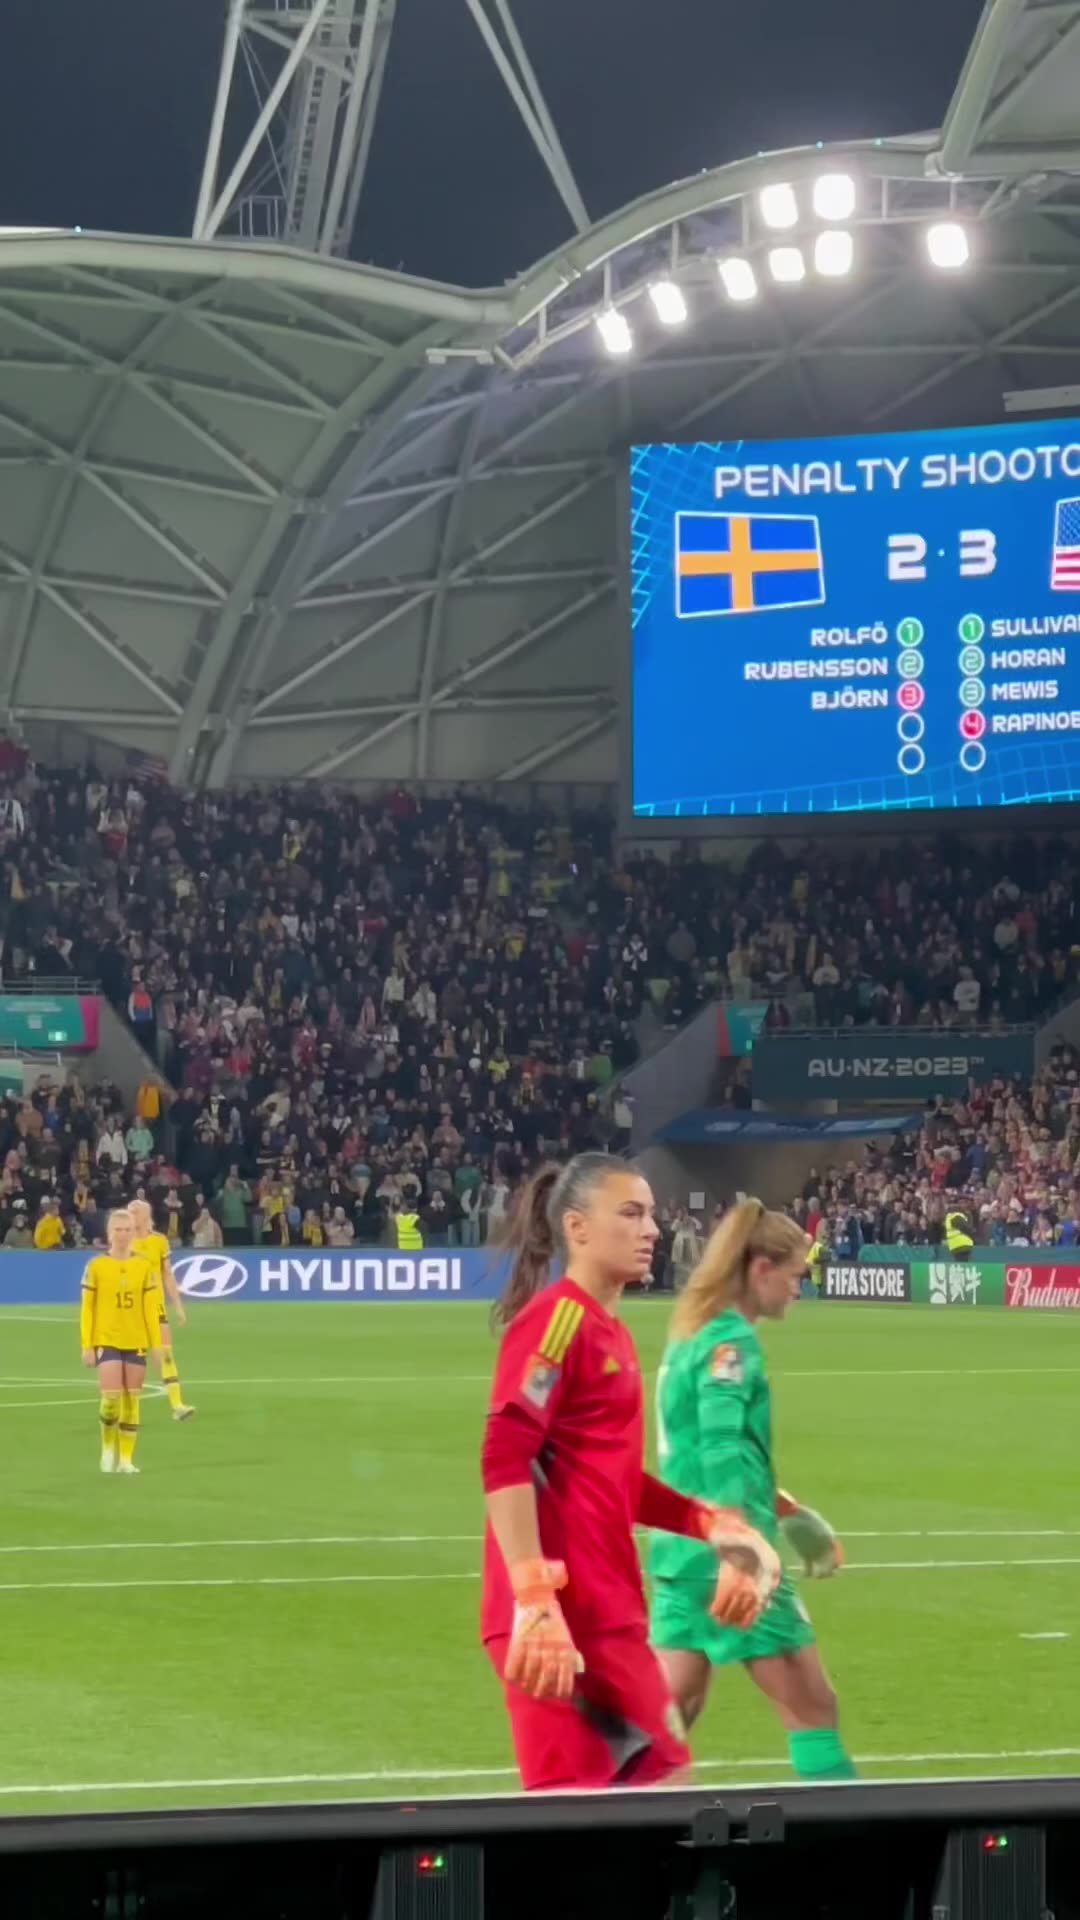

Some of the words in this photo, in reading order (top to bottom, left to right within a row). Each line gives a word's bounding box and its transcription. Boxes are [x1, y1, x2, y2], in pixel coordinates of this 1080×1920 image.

[714, 456, 909, 499] PENALTY
[888, 533, 927, 581] 2
[959, 528, 997, 577] 3
[810, 621, 888, 647] ROLFÖ
[991, 614, 1080, 638] SULLIVA
[744, 657, 888, 680] RUBENSSON
[991, 647, 1066, 669] HORAN
[811, 685, 888, 710] BJÖRN
[991, 679, 1058, 701] MEWIS
[260, 1258, 461, 1292] HYUNDAI
[826, 1267, 859, 1296] FIFA
[859, 1267, 905, 1297] STORE
[115, 1291, 134, 1310] 15
